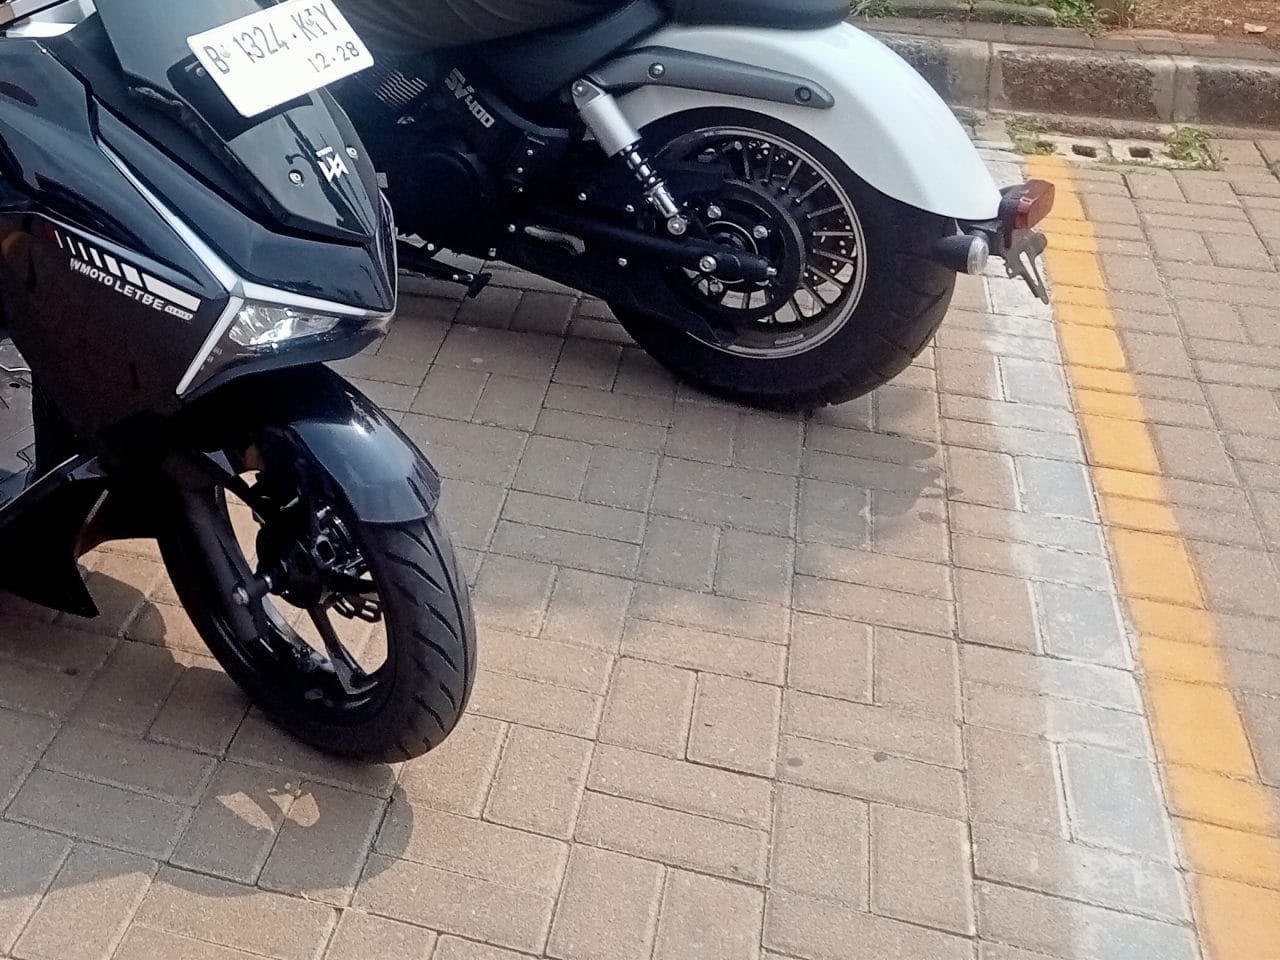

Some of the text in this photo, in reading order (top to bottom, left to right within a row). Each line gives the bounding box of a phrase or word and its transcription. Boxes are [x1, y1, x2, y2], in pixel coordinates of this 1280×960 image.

[202, 45, 230, 74] B
[232, 23, 290, 64] 1324
[69, 257, 114, 286] WMOTO
[114, 279, 165, 311] LETBE
